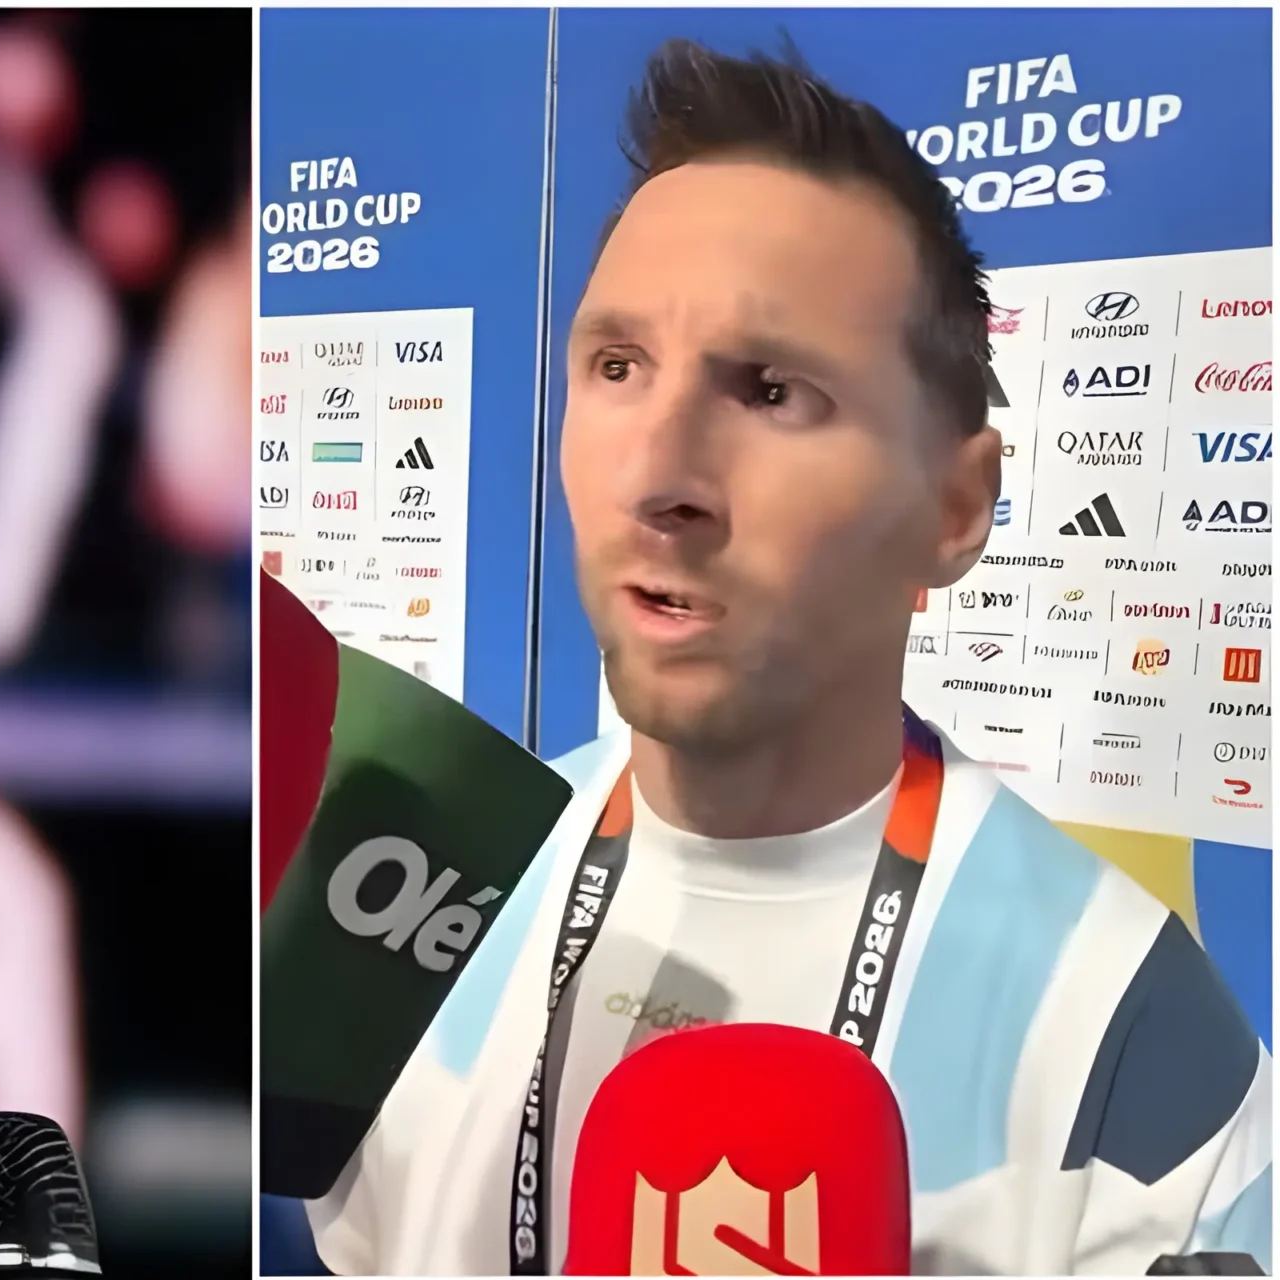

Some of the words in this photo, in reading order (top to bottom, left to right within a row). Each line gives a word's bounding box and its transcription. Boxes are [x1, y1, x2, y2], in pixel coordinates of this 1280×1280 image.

[965, 53, 1077, 109] FIFA
[906, 111, 1057, 166] ORLD
[1068, 94, 1182, 147] CUP
[290, 156, 358, 192] FIFA
[261, 198, 349, 234] ORLD
[354, 192, 422, 227] CUP
[266, 235, 380, 273] 2026
[395, 341, 444, 364] VISA
[1086, 364, 1151, 389] ADI
[1208, 500, 1273, 525] AD
[326, 835, 505, 973] Olé
[568, 863, 609, 930] FIFA
[847, 890, 903, 1018] 2026
